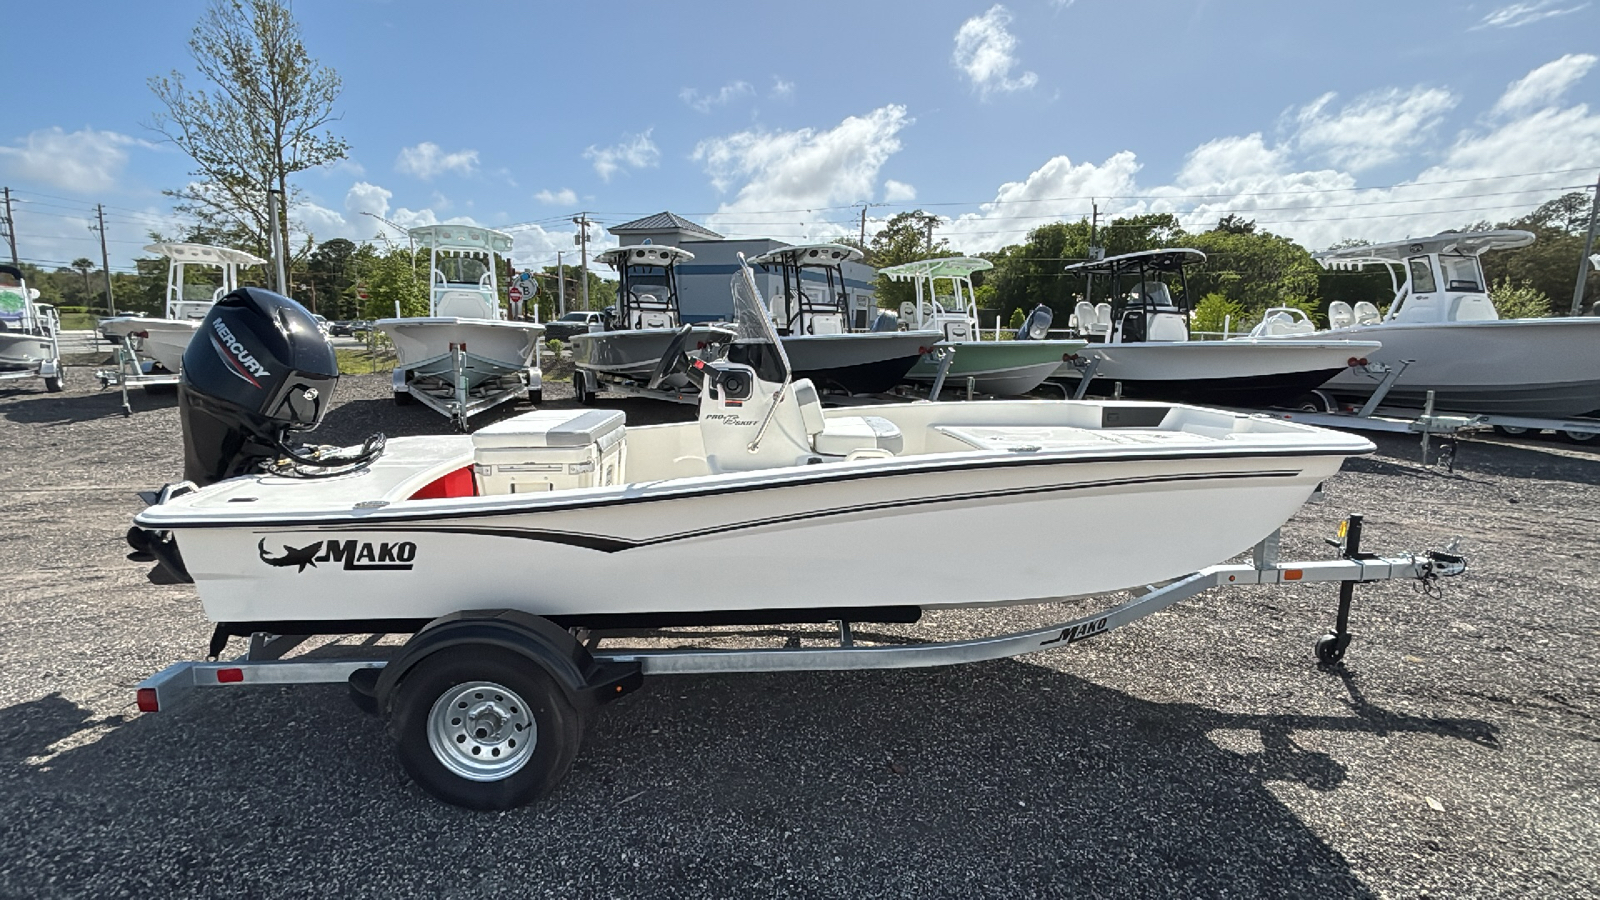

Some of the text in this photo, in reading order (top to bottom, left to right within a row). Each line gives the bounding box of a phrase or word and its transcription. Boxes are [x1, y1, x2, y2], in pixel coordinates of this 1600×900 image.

[212, 317, 271, 378] MERCURY
[315, 539, 417, 571] MAKO
[1041, 617, 1108, 645] MAKO
